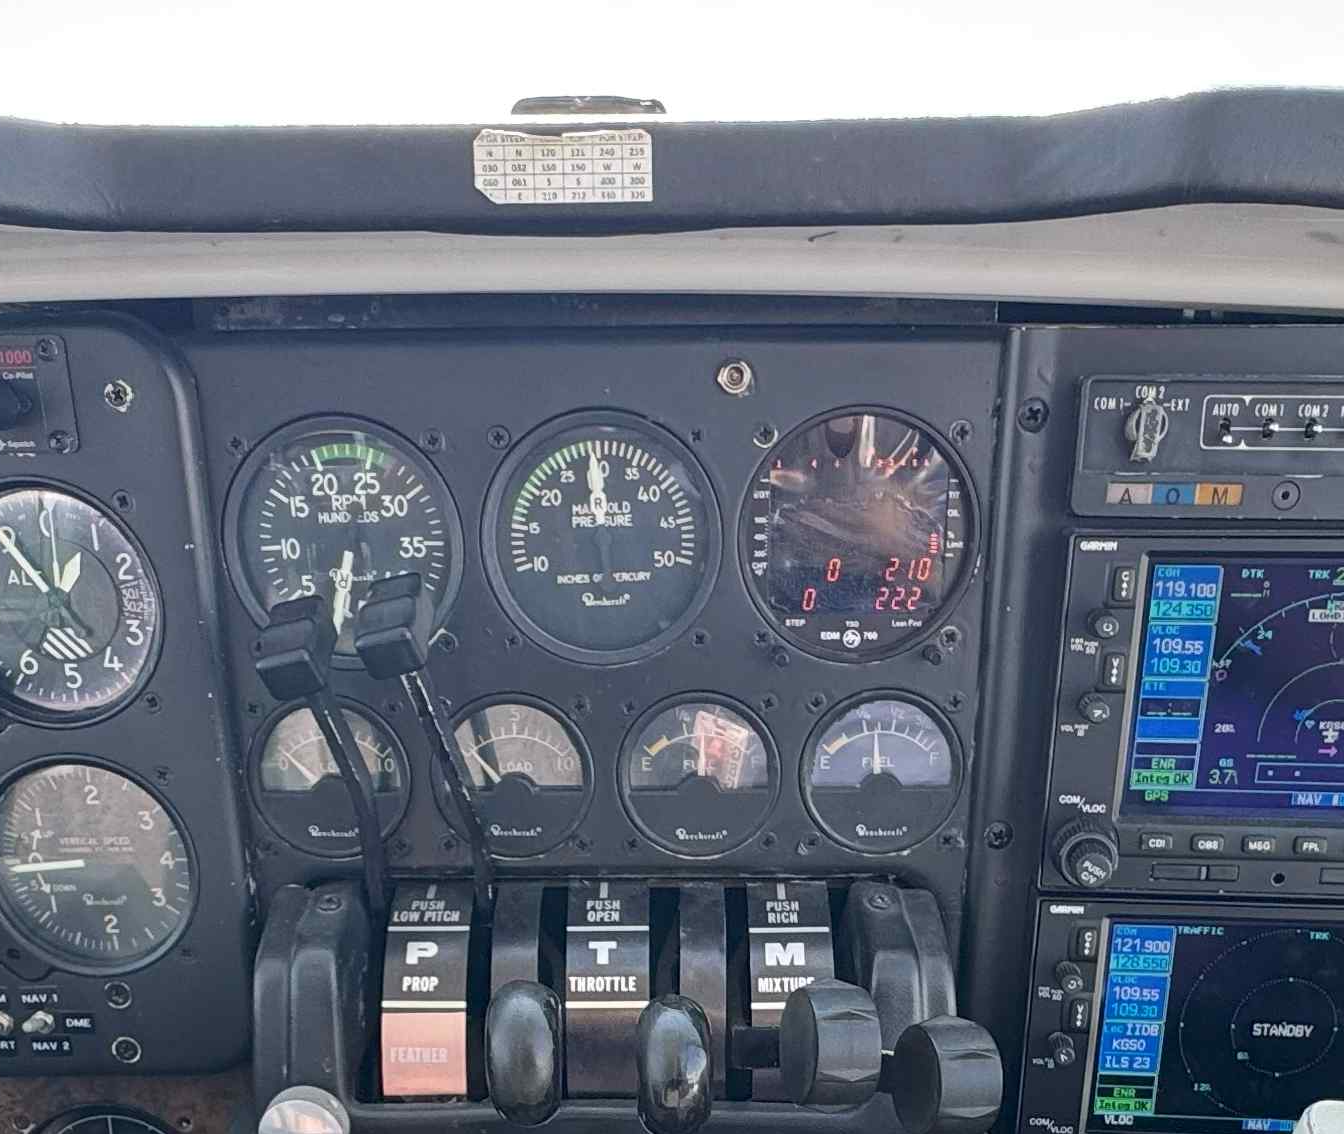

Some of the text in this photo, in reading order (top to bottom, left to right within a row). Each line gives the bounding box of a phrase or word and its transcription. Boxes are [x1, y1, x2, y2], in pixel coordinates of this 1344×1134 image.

[1135, 385, 1165, 399] COM 2
[1170, 399, 1190, 411] EXT
[1213, 404, 1239, 417] AUTO
[1255, 404, 1277, 416] COM
[1298, 404, 1329, 417] COM 2
[560, 470, 575, 483] 25
[625, 468, 640, 481] 35
[311, 472, 380, 496] 20 25
[540, 489, 562, 506] 20
[638, 486, 661, 503] 40
[289, 496, 310, 518] 15
[380, 495, 408, 517] 30
[528, 523, 541, 534] 15
[660, 516, 676, 529] 45
[280, 538, 300, 559] 10
[399, 537, 427, 558] 35
[1080, 541, 1118, 551] GARMIN
[116, 553, 134, 580] 2
[533, 556, 549, 572] 10
[654, 550, 675, 568] 50
[1309, 569, 1331, 580] TRK
[301, 575, 316, 596] 5
[1155, 580, 1217, 598] 119.100
[803, 587, 921, 611] 0 222
[785, 619, 806, 627] STEP
[126, 620, 144, 645] 3
[1152, 638, 1204, 655] 109.55
[19, 649, 39, 674] 6
[104, 647, 123, 671] 4
[1150, 658, 1201, 675] 109.30
[64, 663, 82, 689] 5
[641, 757, 652, 772] E
[819, 755, 831, 770] E
[1151, 758, 1176, 769] ENR
[84, 785, 99, 805] 2
[1144, 790, 1169, 802] GPS
[137, 811, 153, 830] 3
[159, 851, 175, 870] 4
[411, 899, 446, 911] PUSH
[586, 899, 622, 911] PUSH
[765, 900, 801, 913] PUSH
[104, 914, 120, 934] 2
[392, 910, 460, 923] LOW PITCH
[586, 911, 621, 923] OPEN
[767, 912, 799, 925] RICH
[1177, 926, 1224, 936] TRAFFIC
[405, 941, 439, 965] P
[587, 940, 618, 965] T
[1115, 939, 1170, 953] 121.900
[763, 942, 806, 967] M
[401, 976, 439, 992] PROP
[568, 976, 637, 992] THROTTLE
[1113, 987, 1160, 1001] 109.55
[66, 1017, 92, 1028] DME
[1252, 1023, 1314, 1038] STANDBY
[32, 1041, 71, 1051] NAV 2
[389, 1048, 449, 1064] FEATHER
[1104, 1056, 1151, 1069] ILS 23
[1104, 1115, 1134, 1125] VLOC
